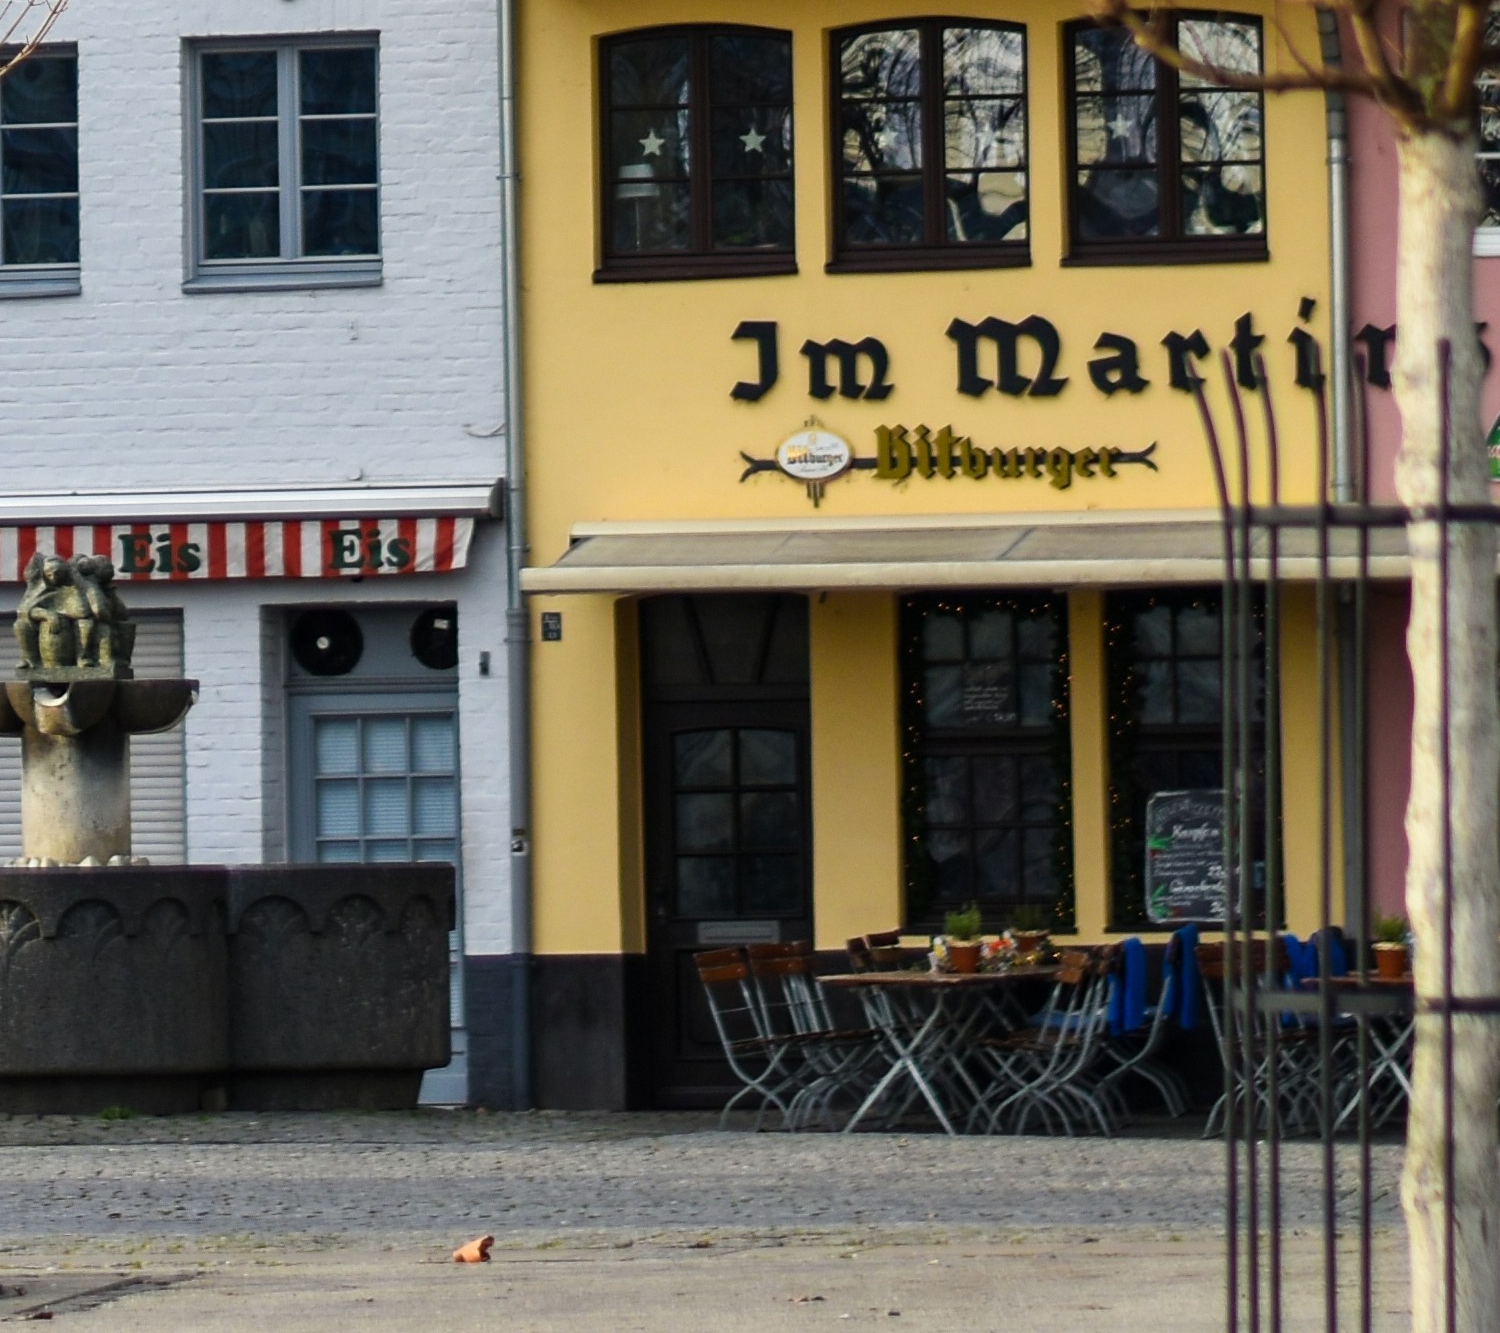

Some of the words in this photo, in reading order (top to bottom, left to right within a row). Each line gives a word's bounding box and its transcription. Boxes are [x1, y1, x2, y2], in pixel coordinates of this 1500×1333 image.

[729, 318, 896, 403] Im
[873, 423, 1123, 490] Bitburger
[117, 531, 203, 575] Eis
[328, 527, 415, 570] Eis
